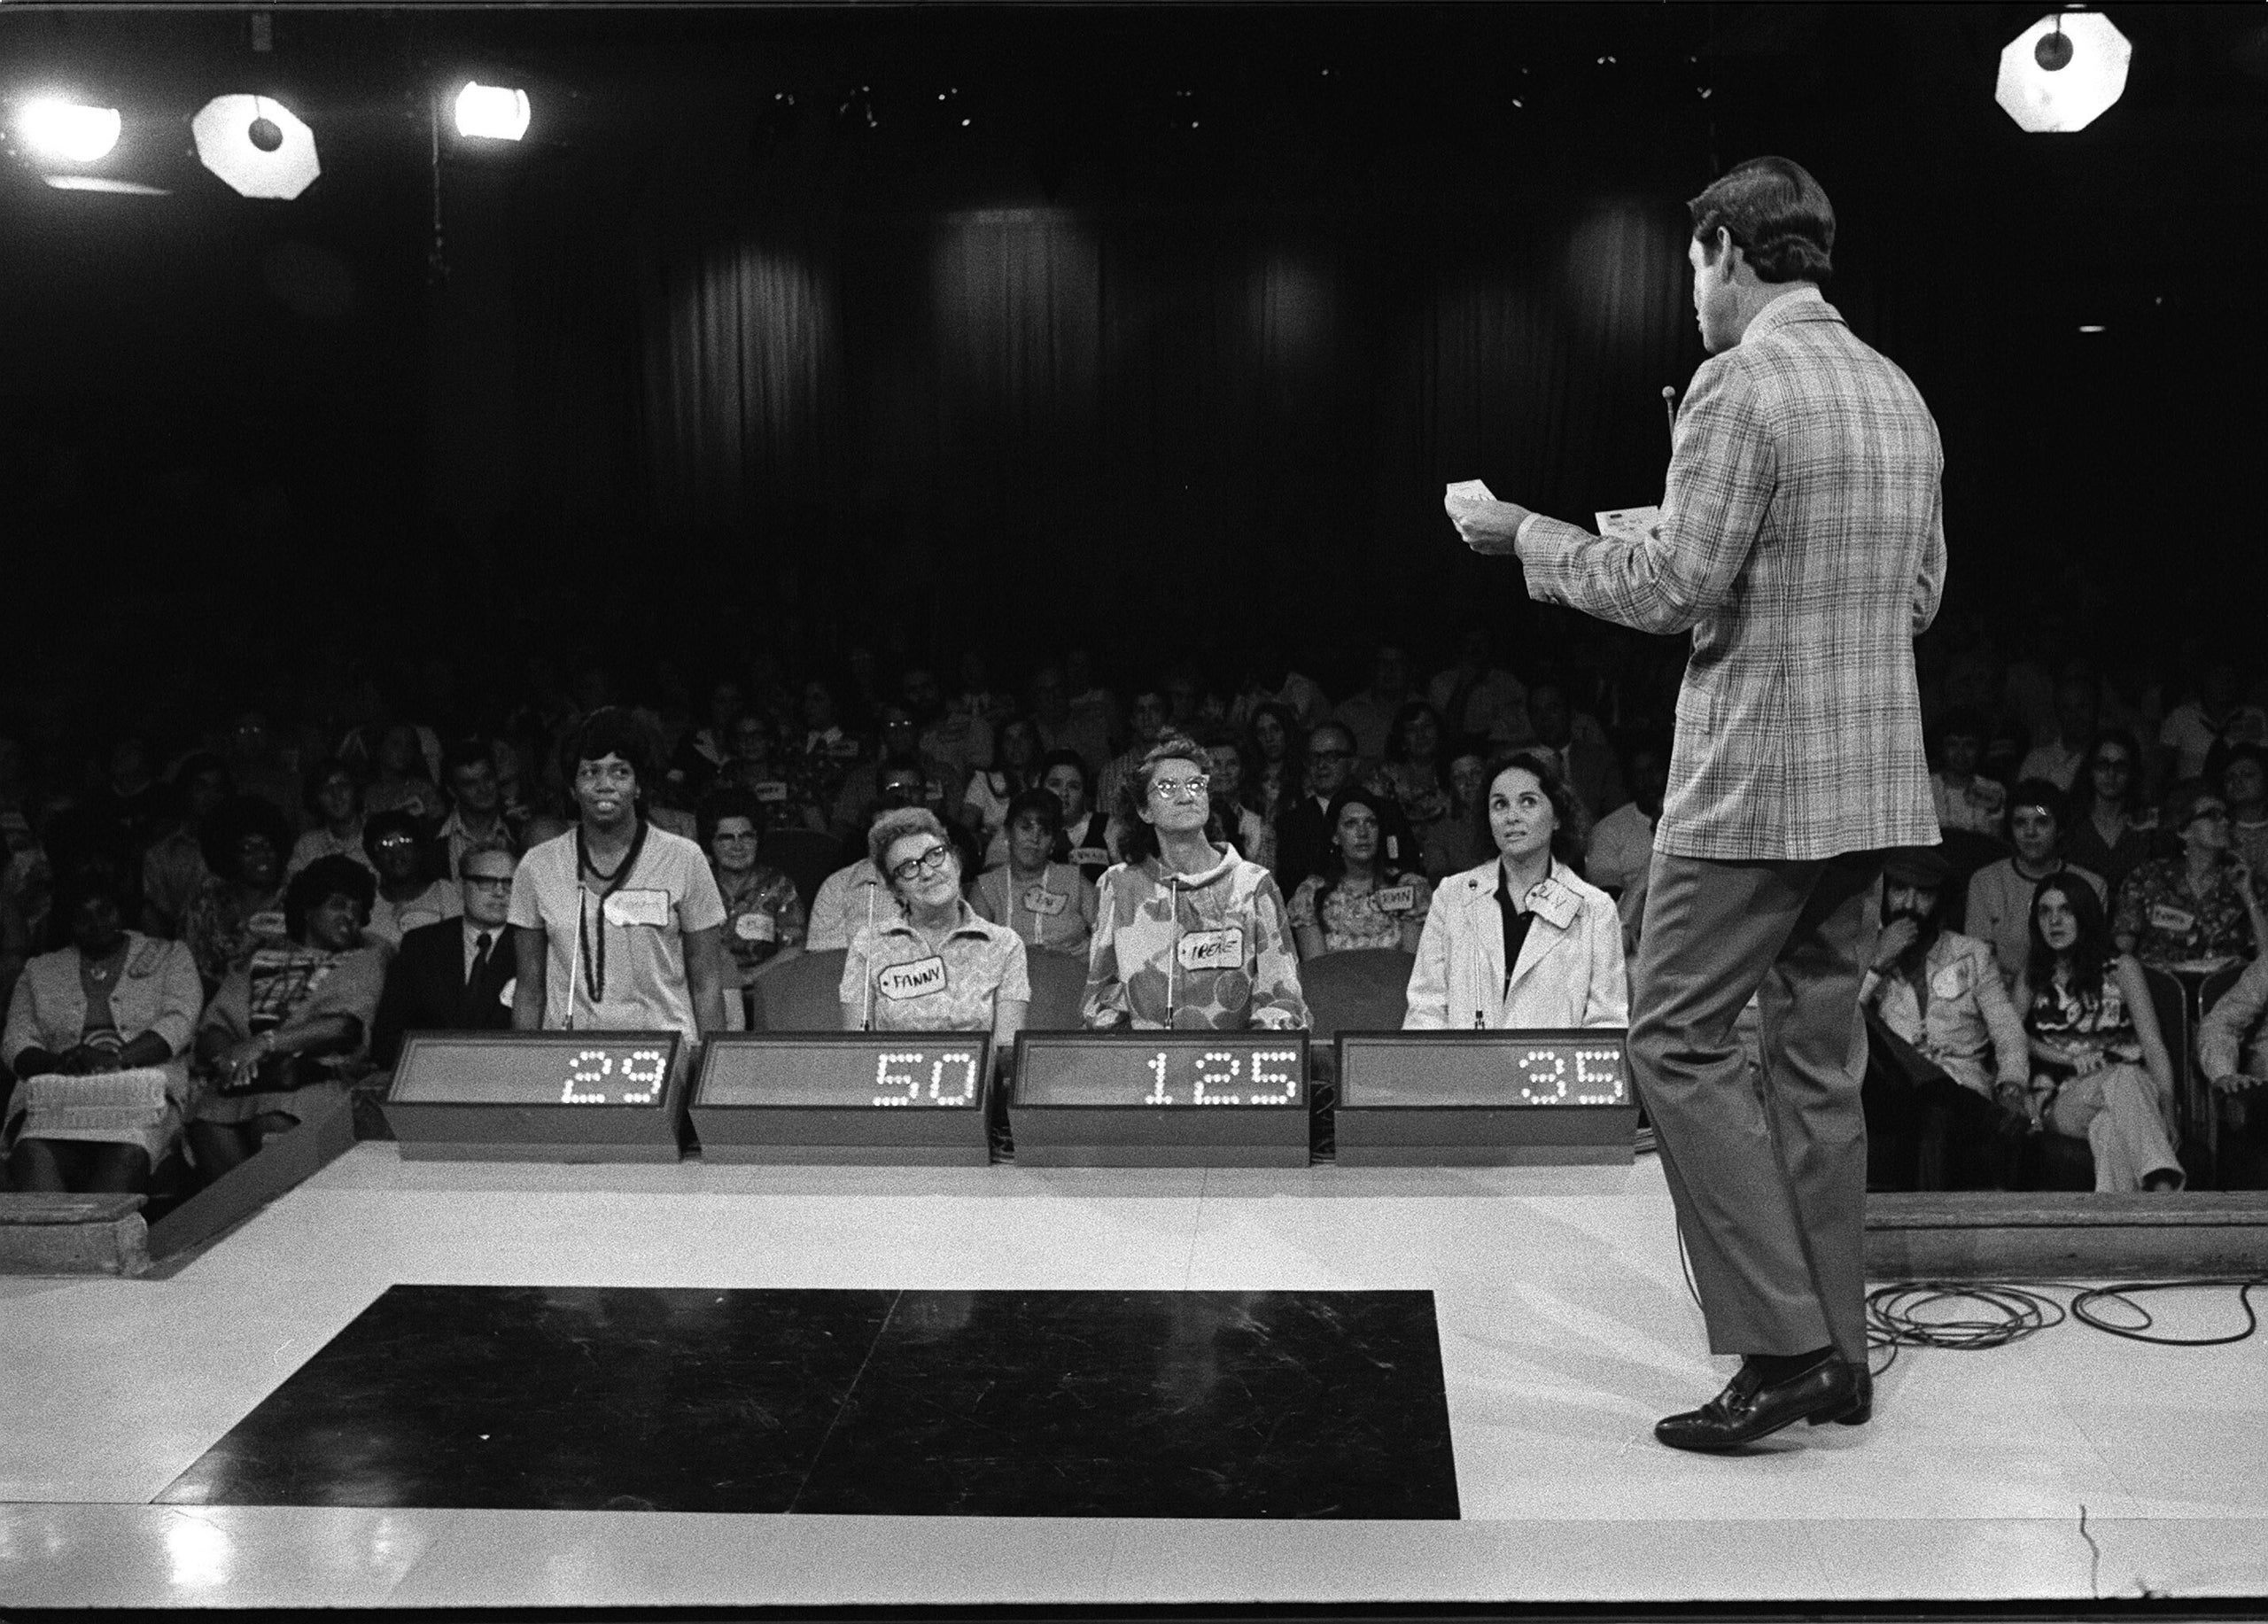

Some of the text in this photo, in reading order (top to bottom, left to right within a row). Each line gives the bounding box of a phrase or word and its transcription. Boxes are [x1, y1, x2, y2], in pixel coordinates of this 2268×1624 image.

[1192, 940, 1238, 961] IRENE
[893, 967, 939, 988] FANNY
[561, 1051, 666, 1104] 29
[872, 1053, 975, 1107] 50
[1145, 1052, 1296, 1105] 125
[1519, 1051, 1623, 1105] 35
